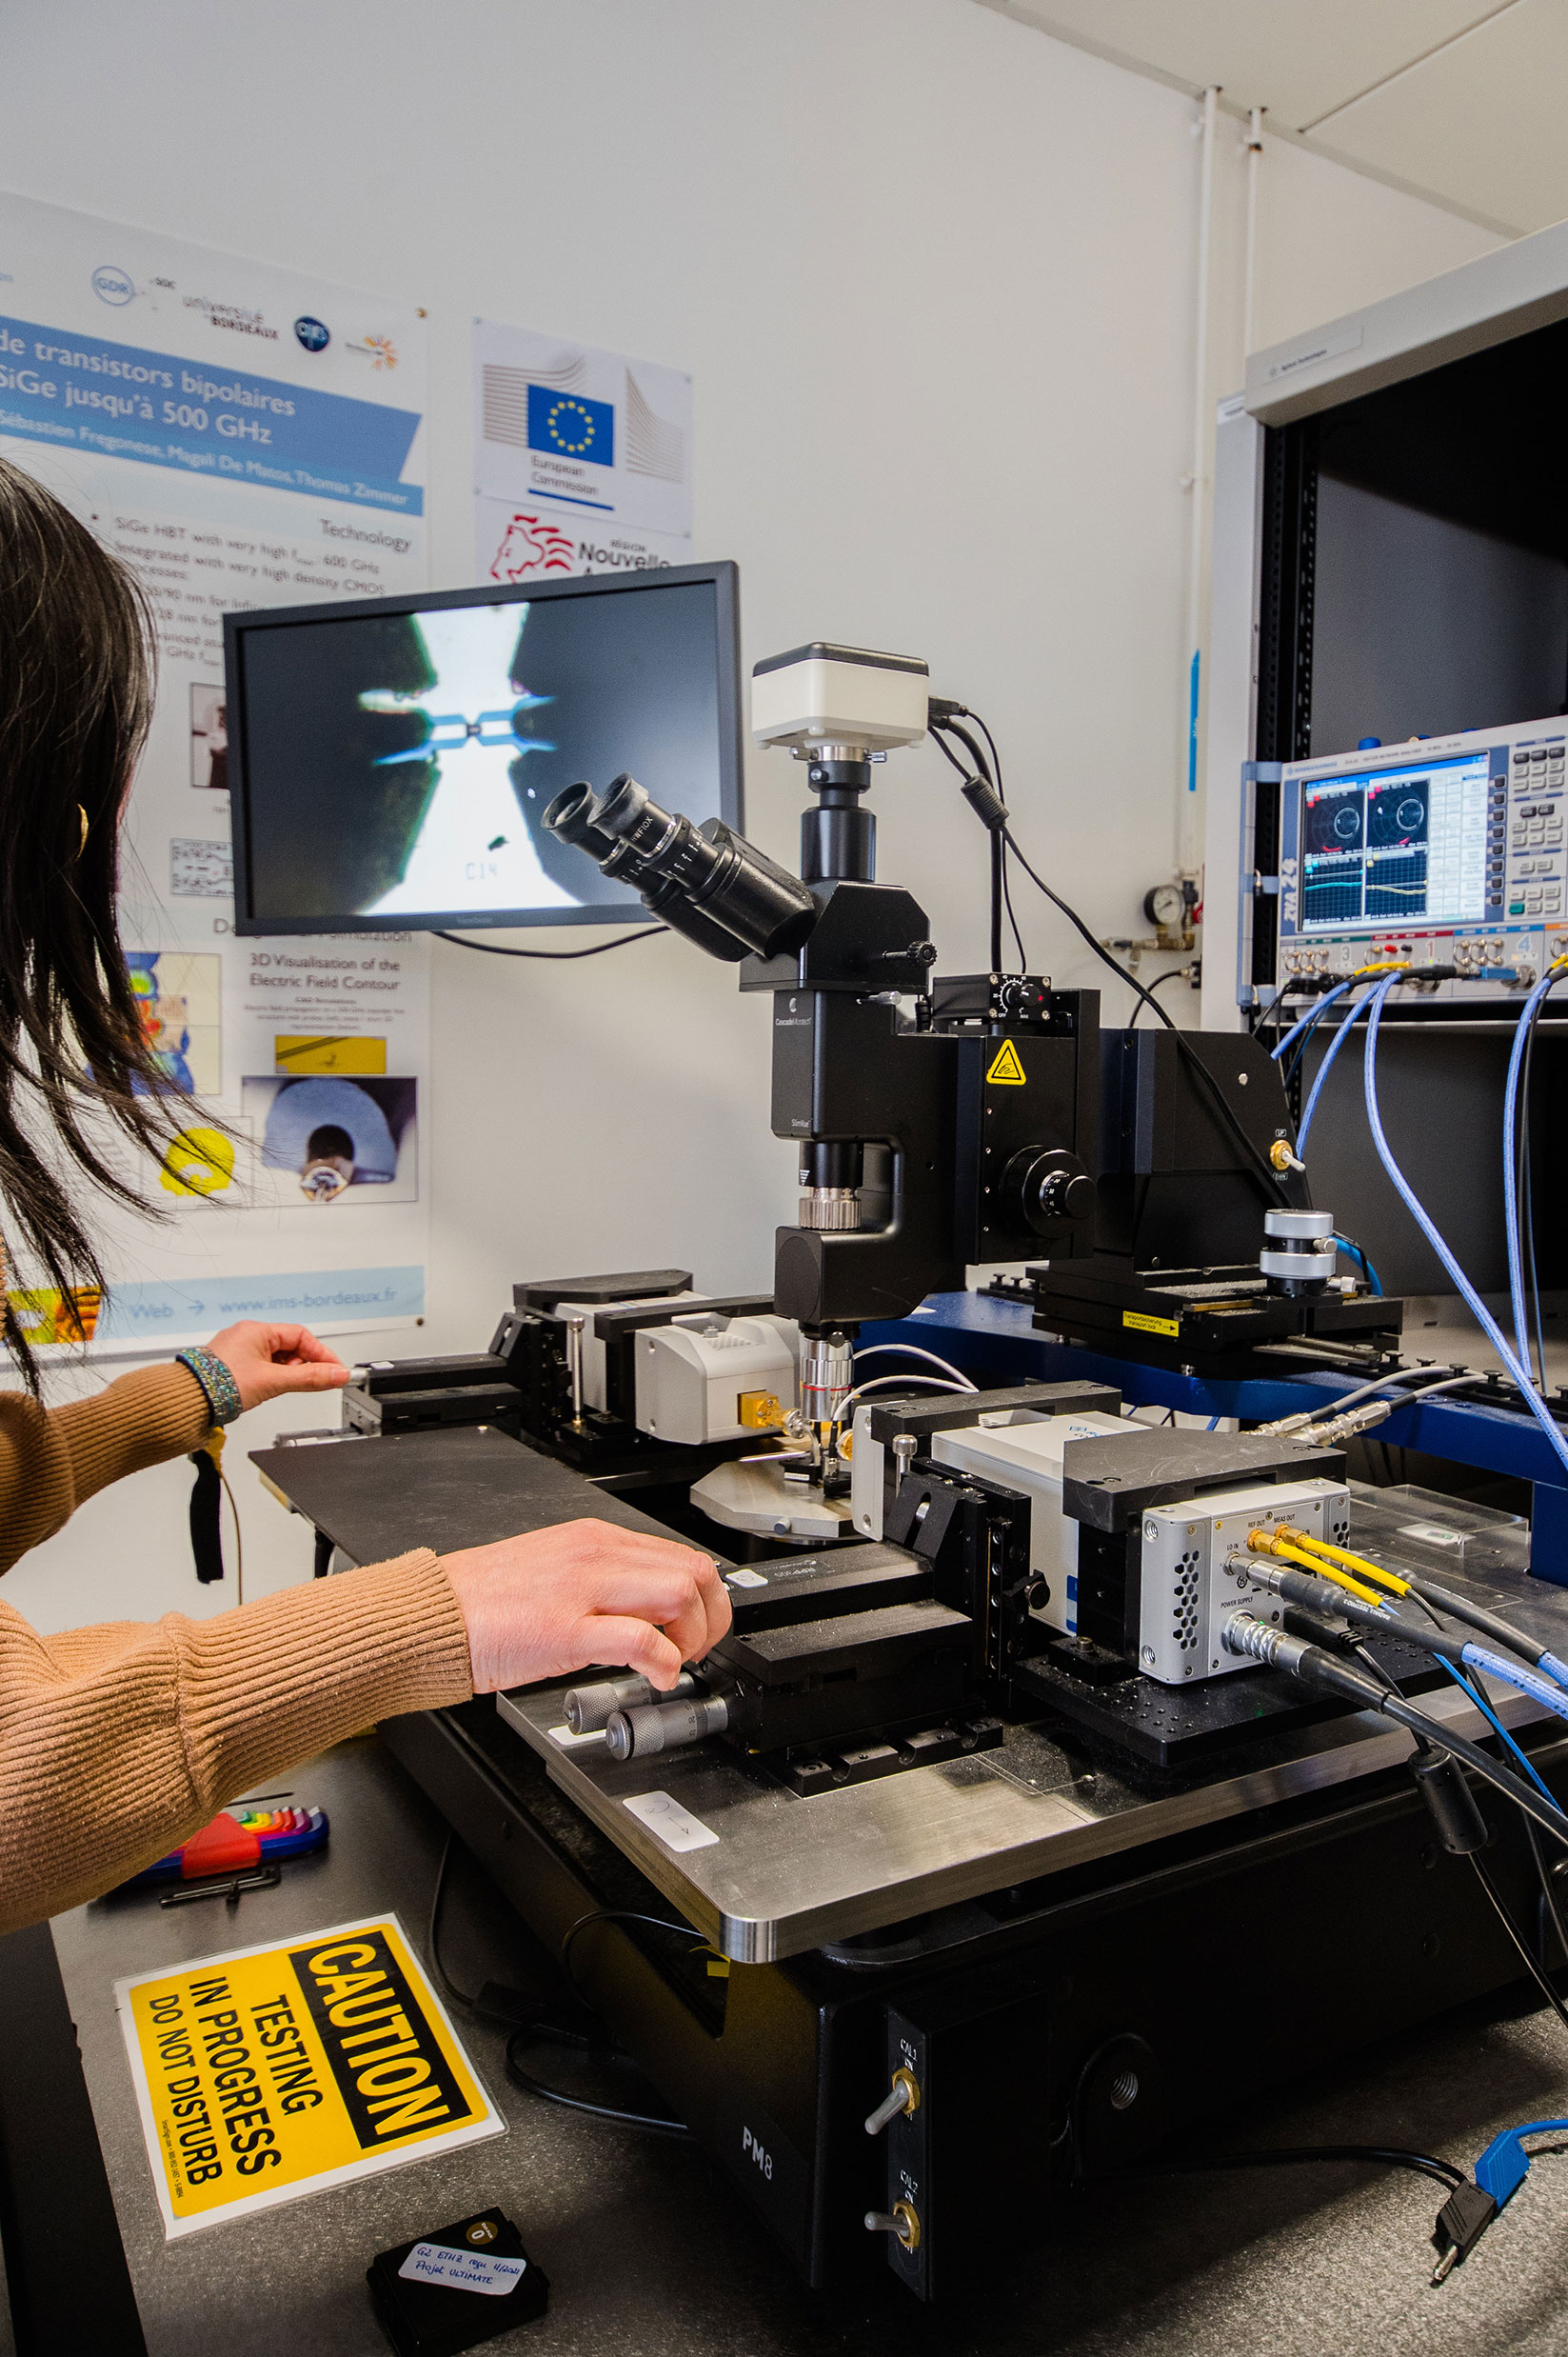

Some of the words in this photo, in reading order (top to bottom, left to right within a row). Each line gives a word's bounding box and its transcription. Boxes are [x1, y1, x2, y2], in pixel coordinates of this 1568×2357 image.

[210, 315, 279, 341] BORDEAUX
[35, 341, 172, 389] transistors
[181, 370, 295, 417] bipolaires
[0, 365, 56, 399] SiGe
[164, 401, 208, 430] 500
[216, 415, 273, 446] GHz
[531, 455, 585, 478] European
[219, 455, 243, 472] De
[294, 469, 350, 495] Thomas
[352, 482, 408, 506] Zimmer
[531, 471, 599, 496] Commission
[320, 519, 411, 553] Technology
[343, 578, 386, 595] CMOS
[1340, 944, 1351, 962] 3
[1426, 940, 1435, 958] 1
[1518, 933, 1532, 951] 4
[250, 952, 270, 968] 3D
[274, 953, 358, 971] Visualisation
[362, 954, 376, 970] of
[378, 957, 401, 971] the
[249, 972, 301, 989] Electric
[307, 974, 339, 989] Field
[342, 975, 401, 991] Contour
[129, 1303, 174, 1320] Web
[218, 1287, 398, 1314] www.ims-bordeaux.fr
[1221, 1599, 1237, 1608] POWER
[1238, 1596, 1253, 1605] SUPPLY
[189, 1976, 231, 2007] IN
[149, 1993, 184, 2024] DO
[156, 2028, 195, 2071] NOT
[308, 1944, 450, 2135] CAUTION
[250, 1994, 324, 2116] TESTING
[198, 2009, 282, 2176] PROGRESS
[168, 2075, 223, 2186] DISTURB
[743, 2126, 773, 2180] PM8
[415, 2260, 444, 2275] Projet
[417, 2247, 432, 2257] G2
[437, 2251, 463, 2263] ETHZ
